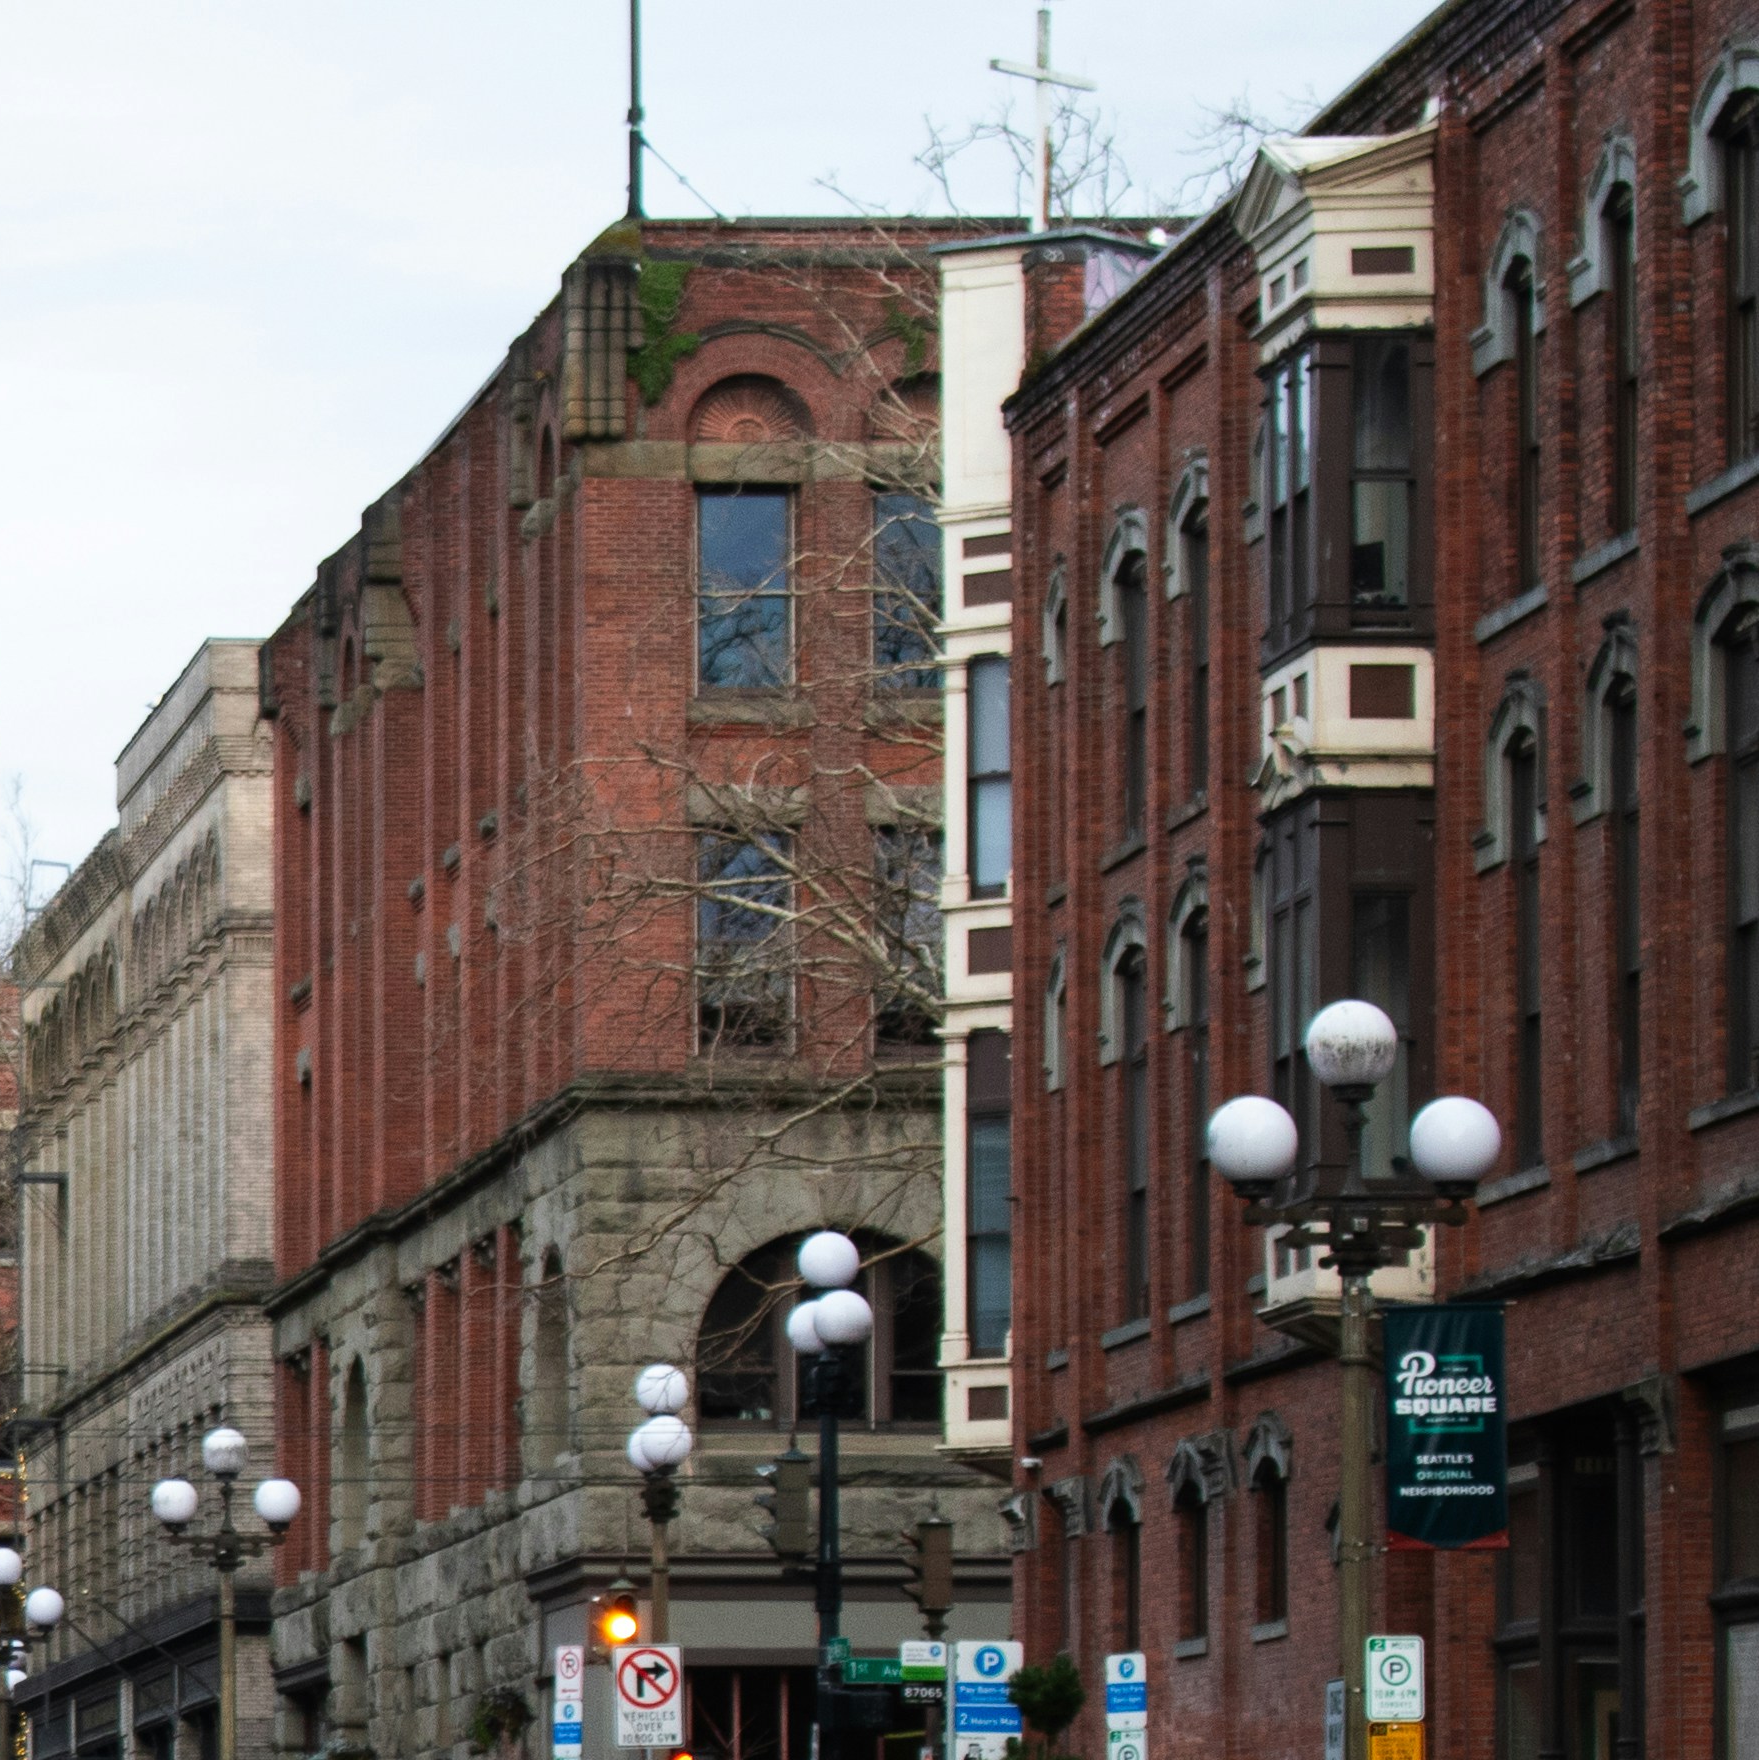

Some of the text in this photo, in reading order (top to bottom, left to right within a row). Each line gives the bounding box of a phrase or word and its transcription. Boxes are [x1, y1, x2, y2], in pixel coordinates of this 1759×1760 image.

[1395, 1350, 1495, 1396] Pioneer
[1394, 1397, 1497, 1416] SQUARE
[1416, 1454, 1474, 1465] SEATTLE'S
[1416, 1470, 1474, 1481] ORIGINAL
[1399, 1485, 1496, 1496] NEIGHBORHOOD
[904, 1686, 944, 1699] 87065
[622, 1711, 676, 1721] VEHICLES
[635, 1722, 664, 1732] OVER
